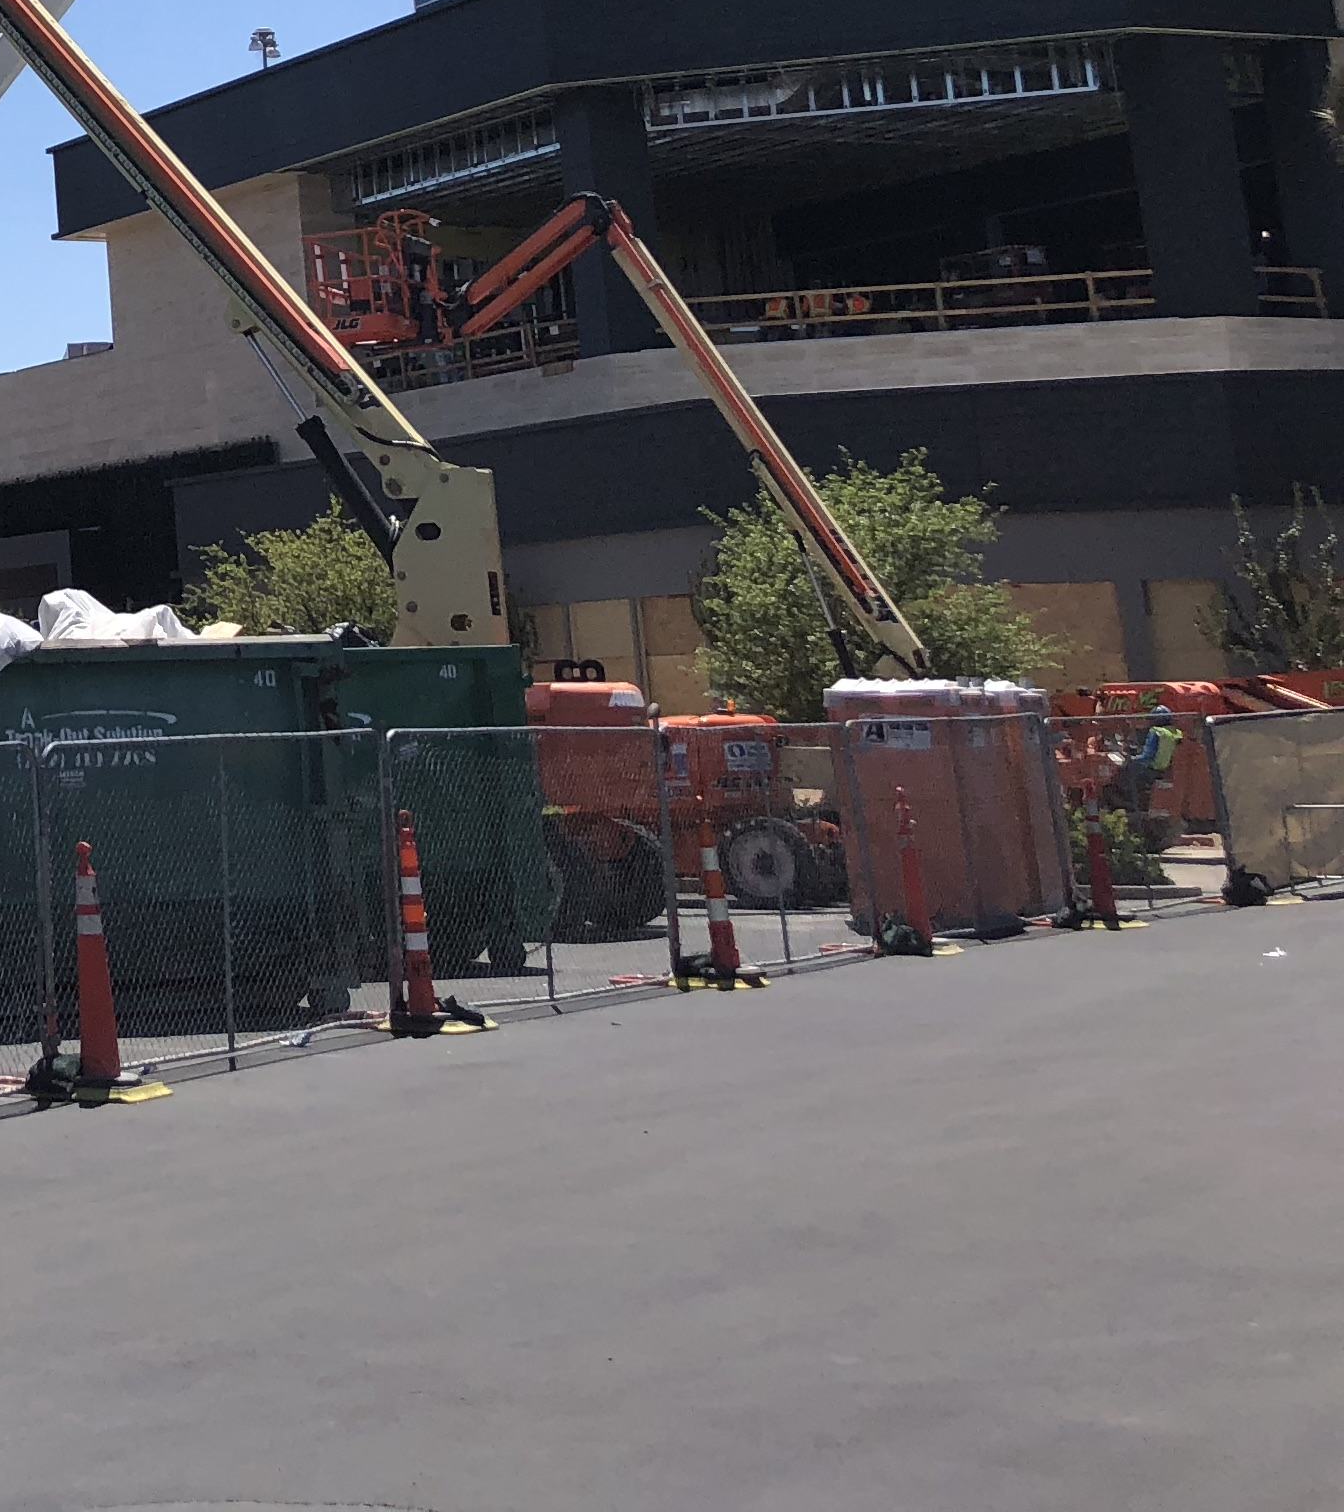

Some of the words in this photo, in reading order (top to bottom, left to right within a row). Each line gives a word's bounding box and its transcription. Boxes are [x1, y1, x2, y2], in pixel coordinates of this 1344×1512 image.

[334, 317, 360, 330] JLG
[254, 669, 276, 687] 40
[439, 664, 457, 679] 40
[21, 707, 35, 729] A
